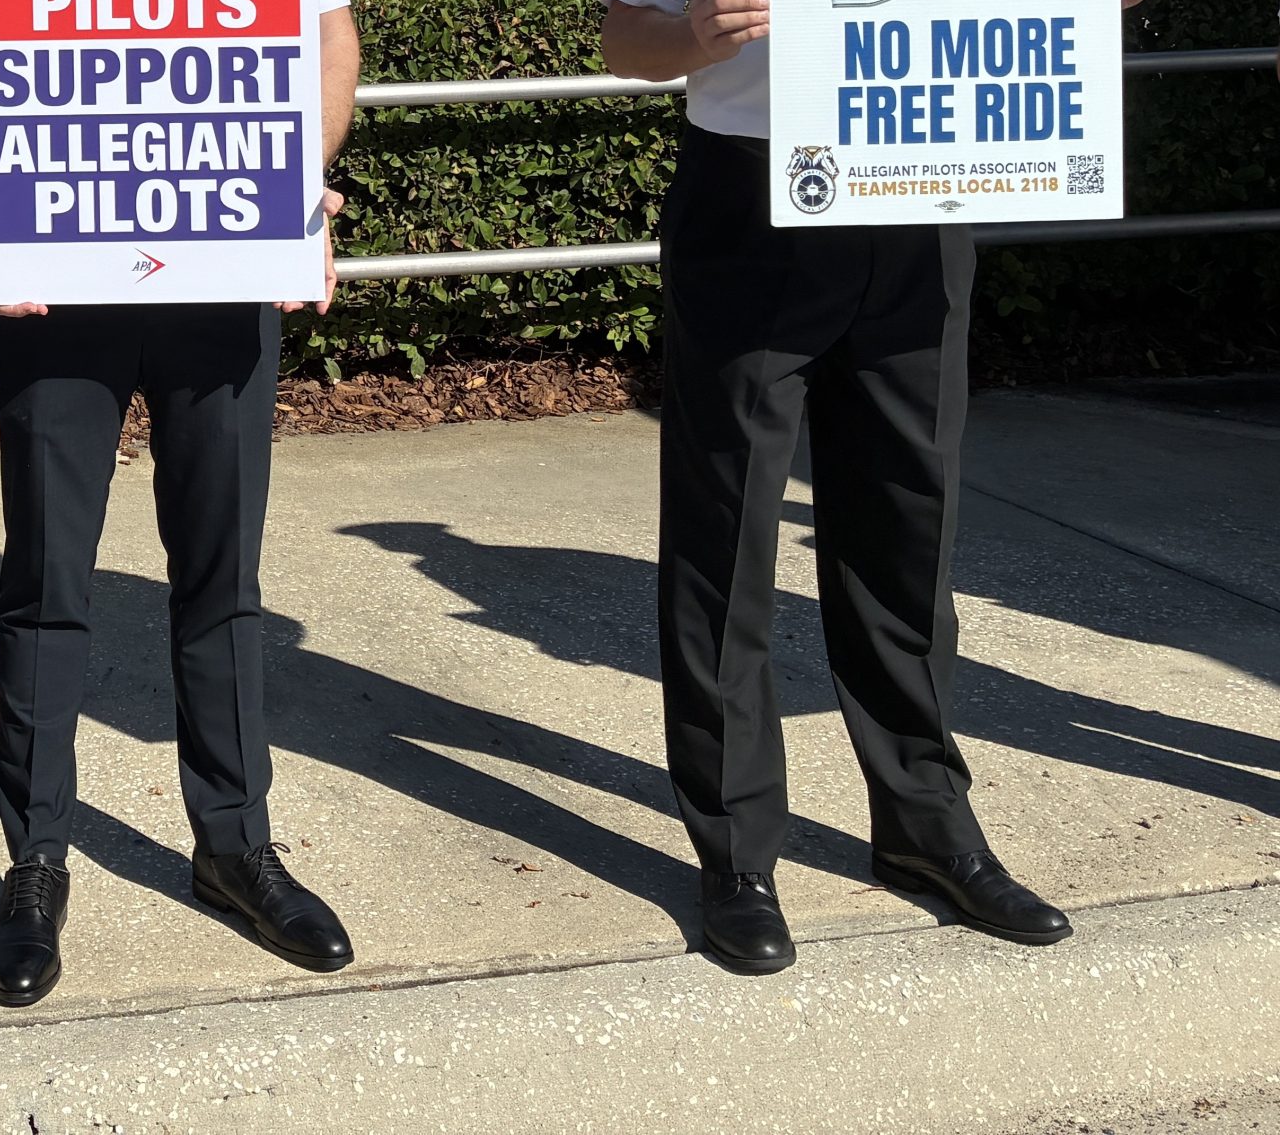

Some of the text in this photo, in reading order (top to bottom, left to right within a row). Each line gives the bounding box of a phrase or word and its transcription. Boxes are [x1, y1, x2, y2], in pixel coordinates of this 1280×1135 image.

[845, 18, 1076, 80] NO MORE
[839, 82, 1083, 145] FREE RIDE
[847, 161, 1056, 178] ALLEGIANT PILOTS ASSOCIATION
[848, 177, 1059, 197] TEAMSTERS LOCAL 2118
[34, 177, 261, 234] PILOTS
[131, 260, 152, 271] APA
